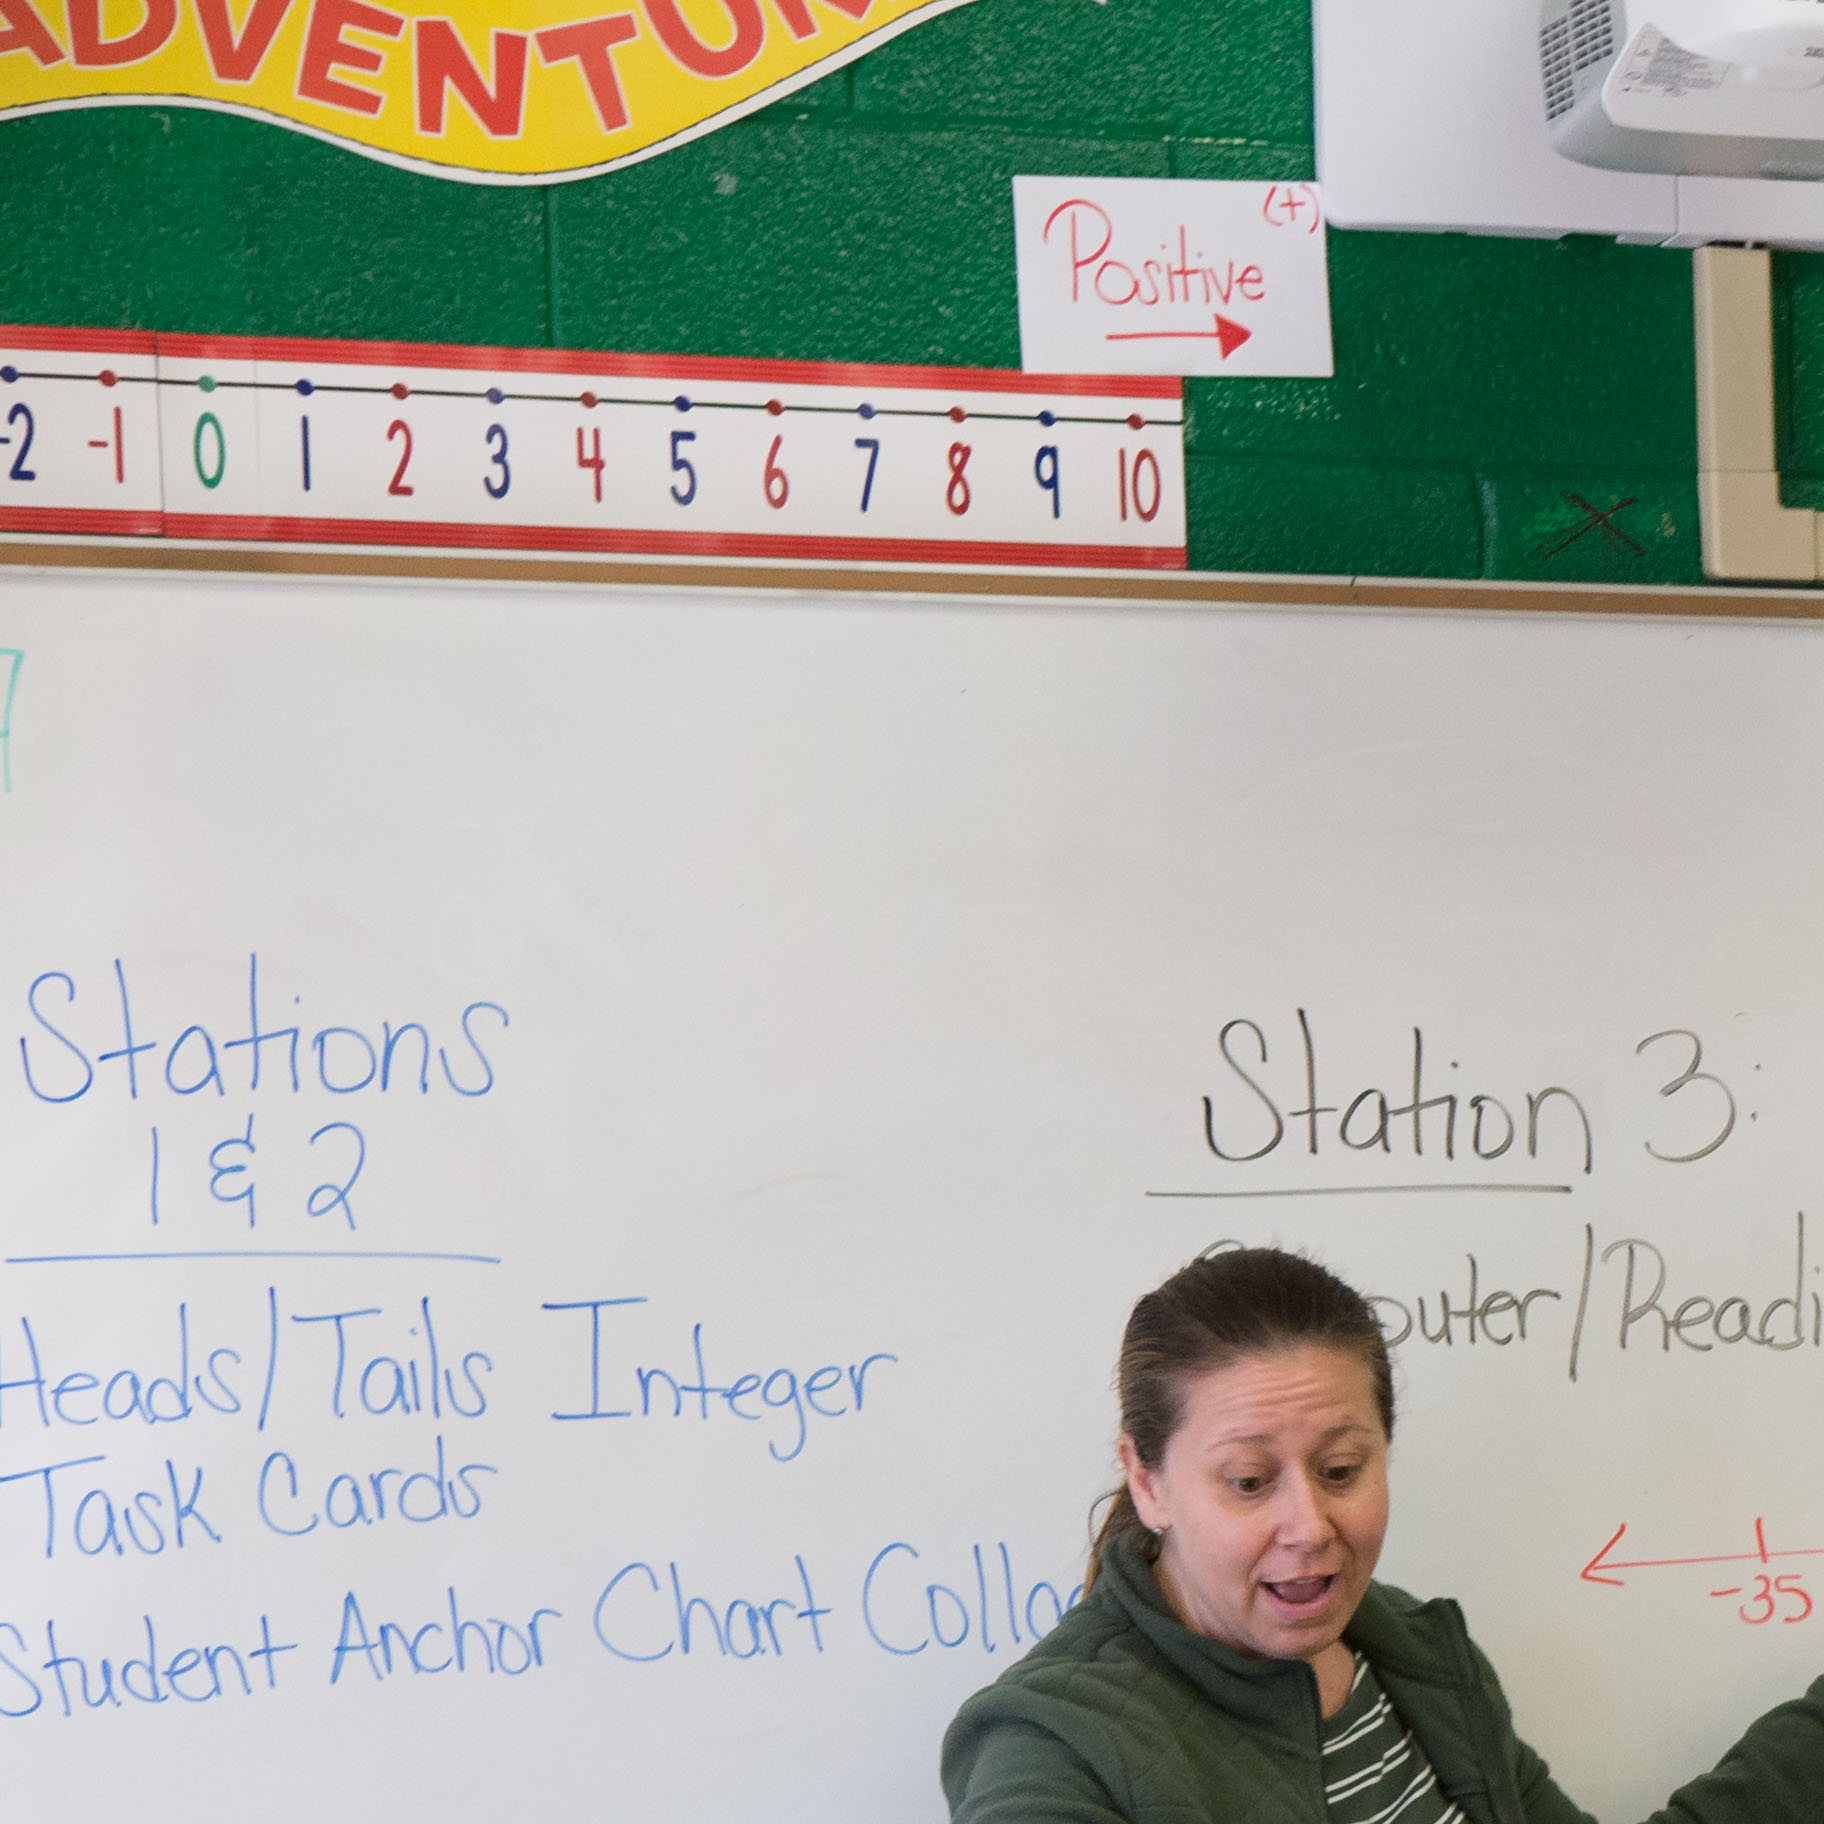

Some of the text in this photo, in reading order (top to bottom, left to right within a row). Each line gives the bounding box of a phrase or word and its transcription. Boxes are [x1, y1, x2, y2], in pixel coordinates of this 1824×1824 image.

[1043, 198, 1266, 306] Positive
[88, 406, 124, 484] -1
[194, 412, 226, 489] 0
[301, 414, 312, 492] 1
[387, 419, 414, 496] 2
[484, 423, 511, 499] 3
[576, 426, 605, 503] 4
[670, 431, 697, 506] 5
[763, 435, 789, 509] 6
[855, 438, 879, 513] 7
[945, 442, 971, 516] 8
[1034, 445, 1060, 519] 9
[1118, 447, 1161, 523] 10
[20, 952, 509, 1104] Stations
[1201, 1007, 1763, 1175] Station 3:
[150, 1126, 160, 1226] 1
[306, 1121, 367, 1231] 2
[541, 1296, 899, 1462] Integer
[0, 1434, 499, 1560] Task Cards
[0, 1612, 298, 1718] Student
[328, 1585, 564, 1686] Anchor
[592, 1552, 832, 1665] Chart
[1708, 1573, 1814, 1626] -35
